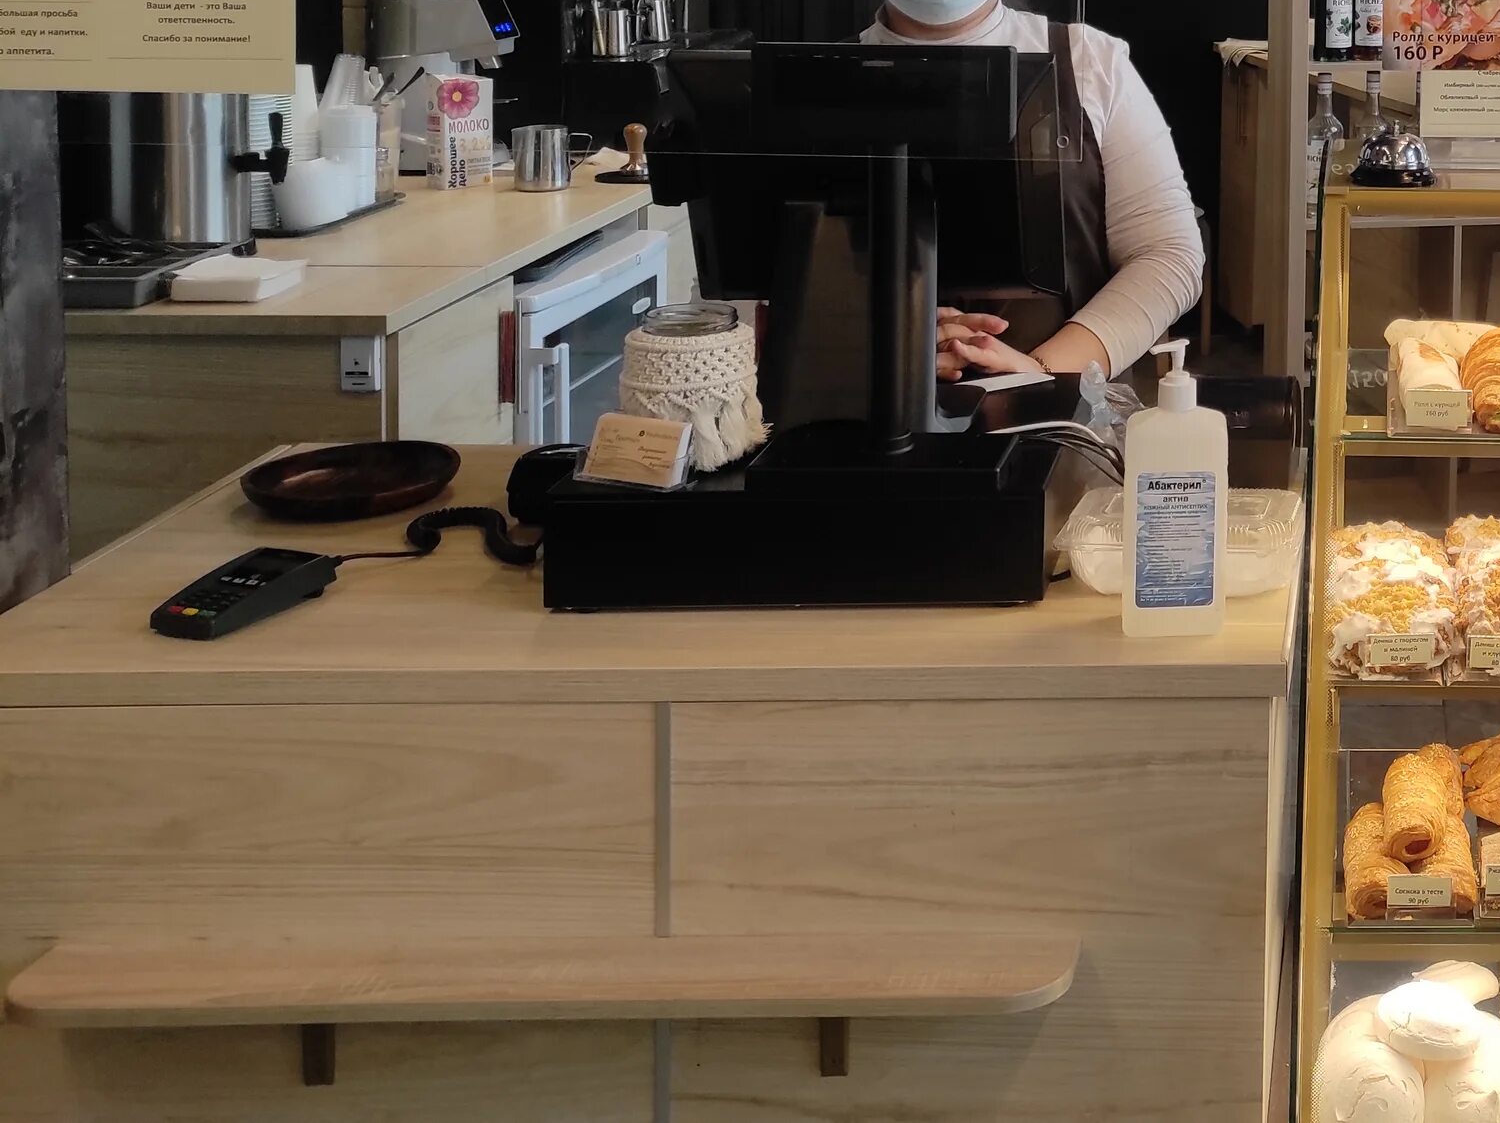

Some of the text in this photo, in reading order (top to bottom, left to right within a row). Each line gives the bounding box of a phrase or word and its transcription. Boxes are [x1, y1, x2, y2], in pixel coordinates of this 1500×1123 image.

[142, 34, 180, 43] Спасибо
[195, 35, 251, 44] понимание!
[1392, 31, 1494, 45] Ролл с курицей
[1393, 46, 1427, 60] 160
[448, 118, 490, 134] МОЛОКО
